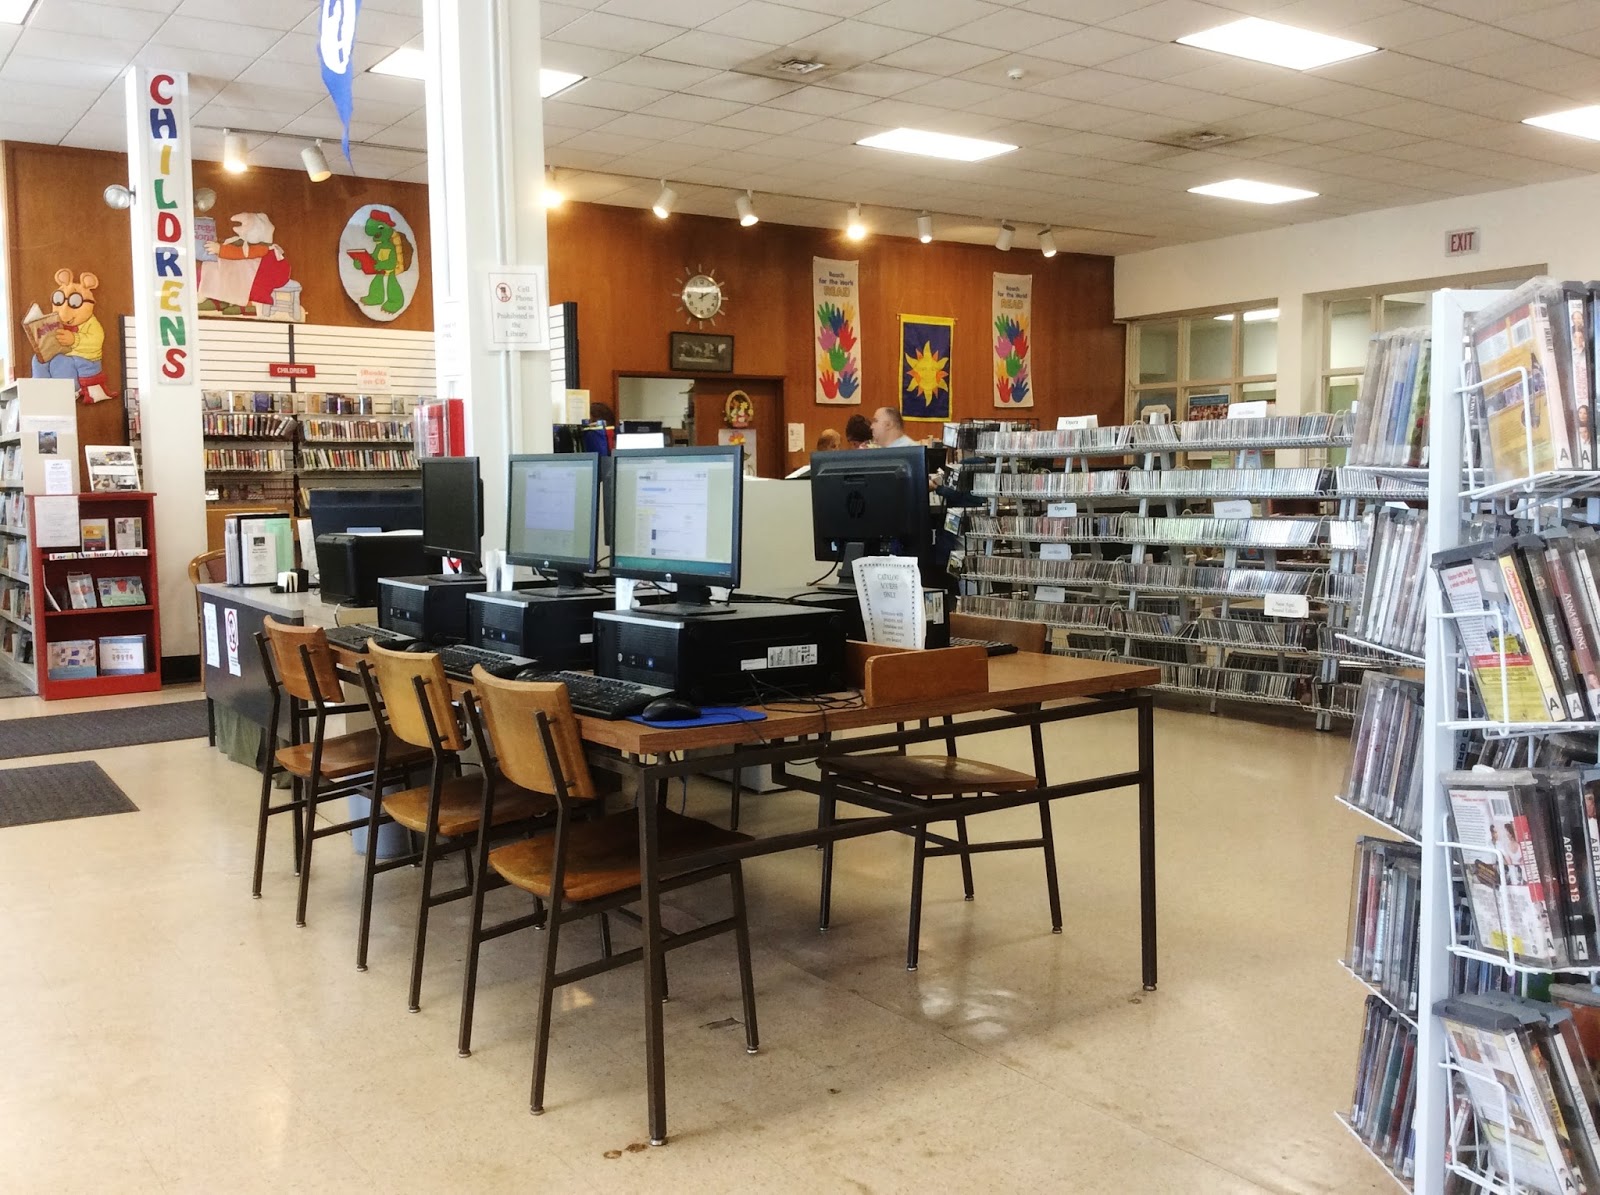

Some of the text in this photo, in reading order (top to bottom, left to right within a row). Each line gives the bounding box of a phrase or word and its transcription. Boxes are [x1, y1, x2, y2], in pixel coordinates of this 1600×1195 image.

[149, 74, 188, 379] CHILDRENS
[1451, 232, 1474, 252] EXIT
[277, 366, 308, 374] CHILDRENS
[1560, 448, 1570, 462] A
[1582, 450, 1590, 462] A
[1564, 593, 1576, 616] ANNA
[1575, 627, 1587, 650] KING
[1545, 614, 1570, 680] Animal Crackers
[1550, 697, 1560, 711] A
[1572, 698, 1582, 712] A
[1526, 841, 1540, 883] APARTMENT
[1563, 836, 1580, 902] APOLLO 18
[1546, 938, 1554, 950] A
[1578, 940, 1586, 954] A
[1572, 1085, 1598, 1145] ARRANGED
[1565, 1176, 1574, 1188] A
[1576, 1174, 1584, 1185] A
